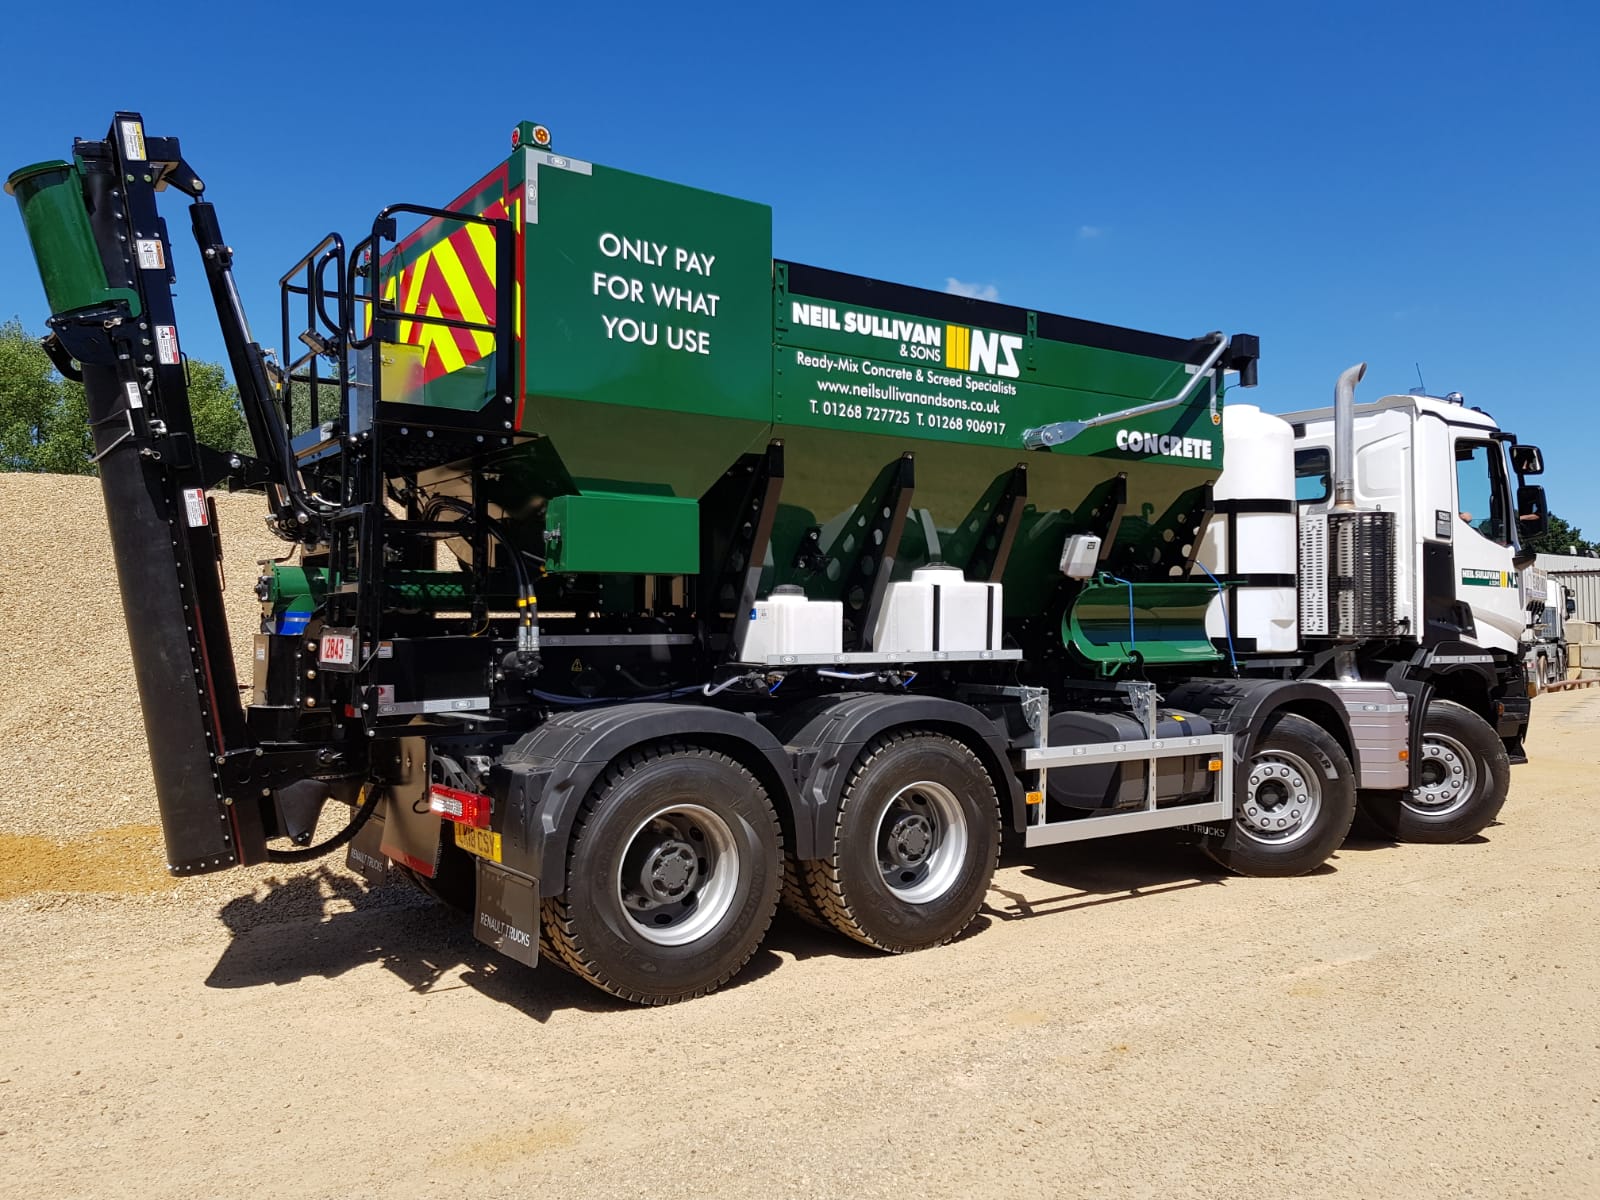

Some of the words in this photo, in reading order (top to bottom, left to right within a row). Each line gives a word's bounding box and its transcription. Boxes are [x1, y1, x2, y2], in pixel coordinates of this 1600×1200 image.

[599, 233, 667, 267] ONLY
[675, 248, 715, 276] PAY
[593, 272, 645, 303] FOR
[652, 283, 720, 316] WHAT
[602, 315, 657, 345] YOU
[667, 326, 710, 355] USE
[792, 302, 841, 331] NEIL
[844, 312, 941, 347] SULLIVAN
[900, 344, 908, 357] &
[910, 346, 941, 362] SONS
[969, 329, 1023, 379] NS
[797, 351, 859, 373] Ready-Mix
[862, 361, 912, 381] Concrete
[916, 370, 924, 382] &
[928, 371, 963, 388] Screed
[965, 377, 1017, 396] Specialists
[817, 380, 1000, 414] www.neilsullivanandsons.co.uk
[810, 400, 819, 414] T.
[823, 401, 862, 419] 01268
[866, 407, 910, 424] 727725
[917, 413, 925, 426] T.
[928, 414, 963, 431] 01268
[966, 419, 1006, 435] 906917
[1116, 429, 1212, 460] CONCRETE
[1193, 824, 1225, 838] TRUCKS
[480, 912, 505, 934] RENAULT
[505, 924, 530, 947] TRUCKS
